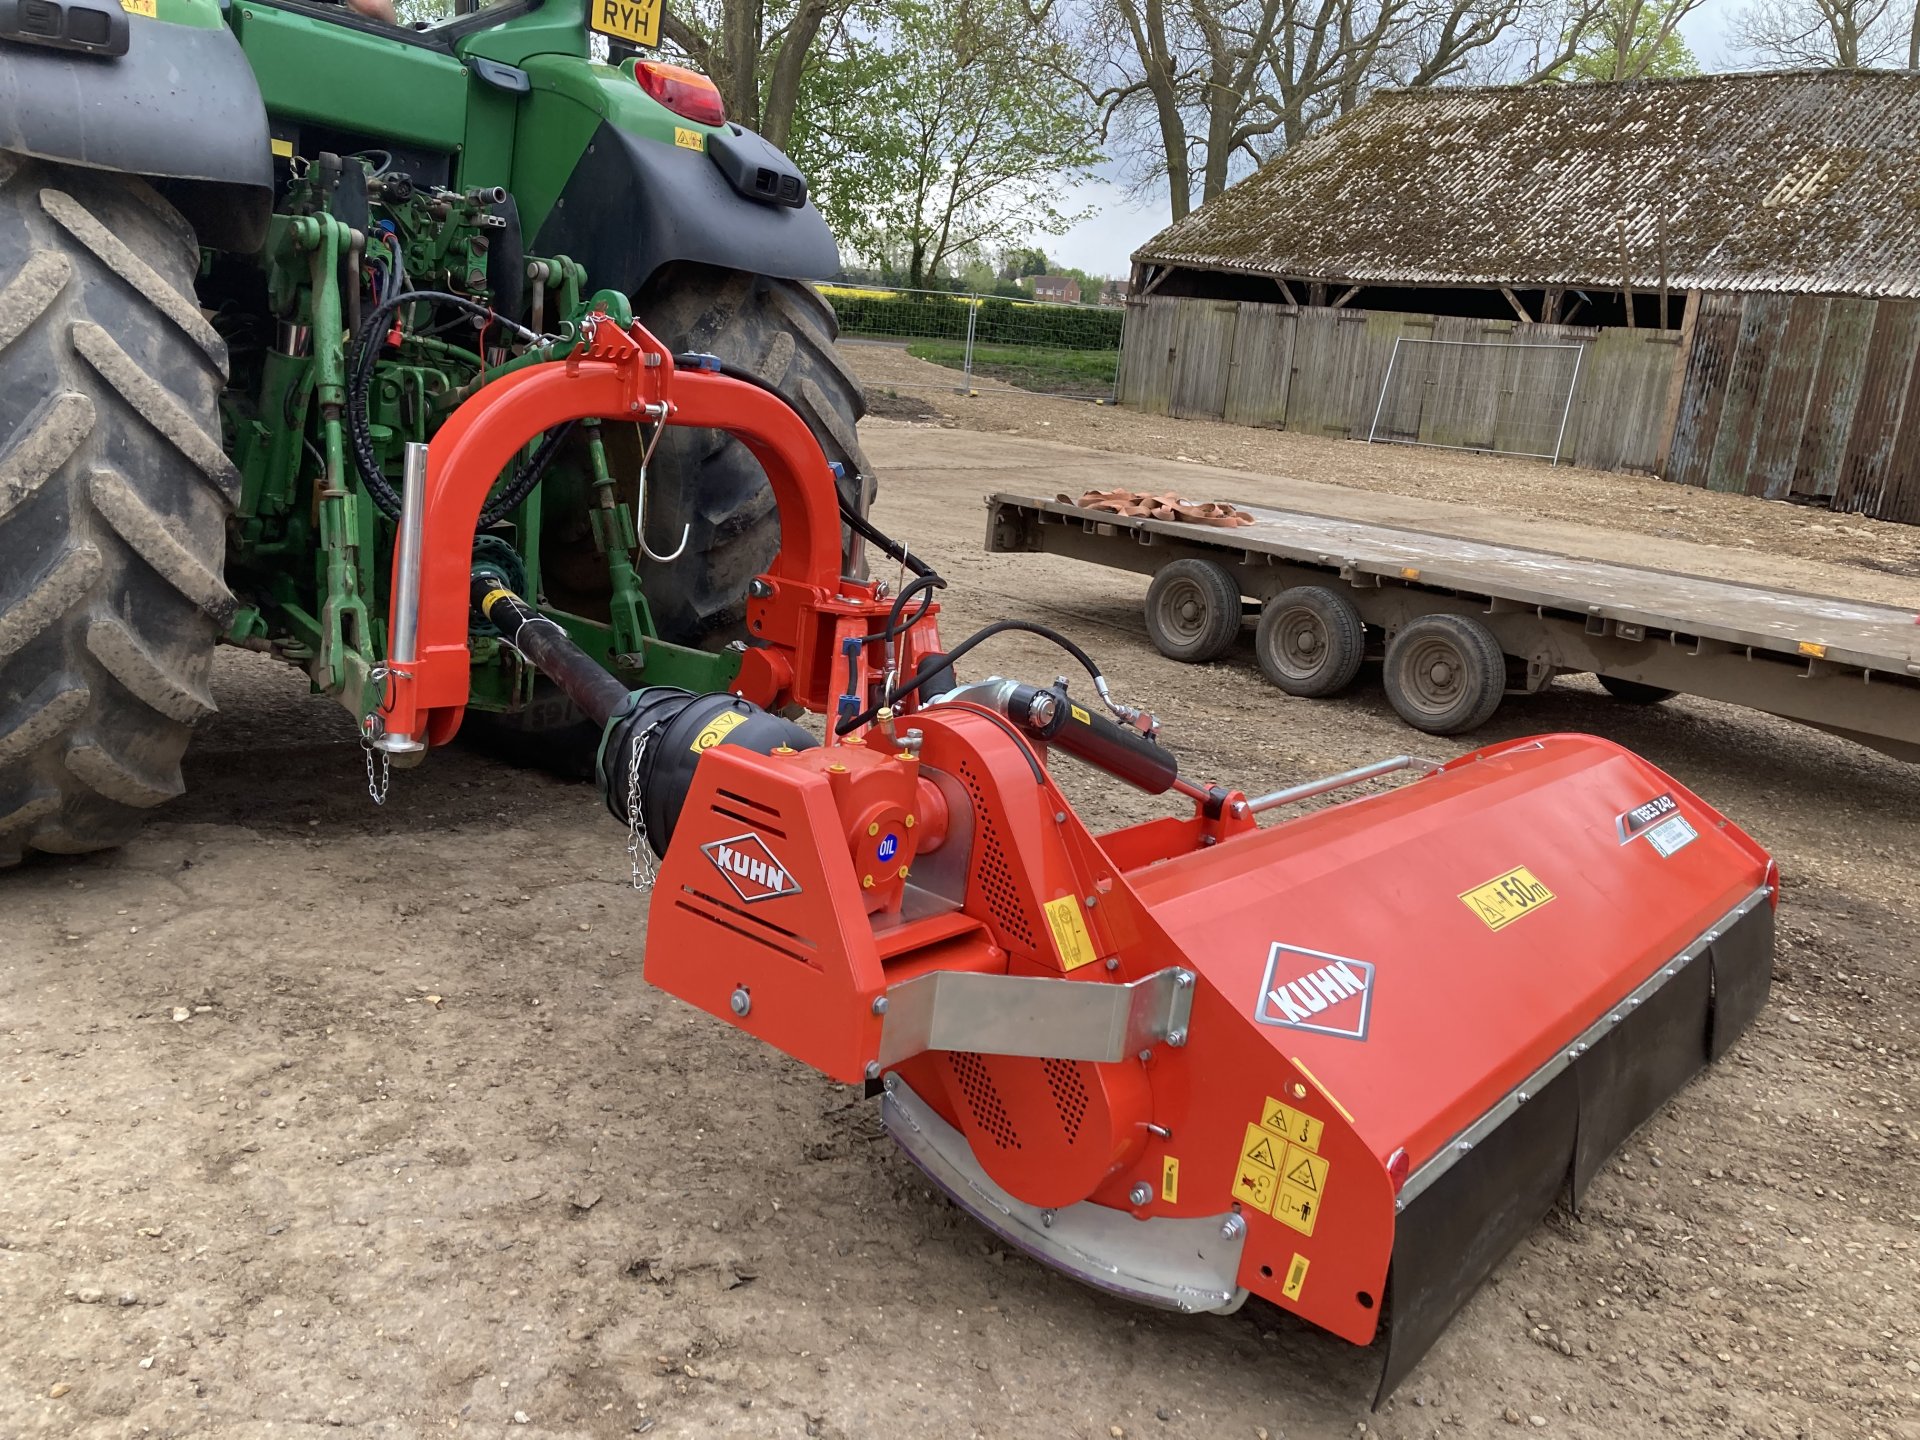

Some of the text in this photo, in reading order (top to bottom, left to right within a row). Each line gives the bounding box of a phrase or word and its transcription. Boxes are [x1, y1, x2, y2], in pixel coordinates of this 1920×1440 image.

[603, 0, 649, 36] RYH
[1631, 795, 1677, 823] TBES 242
[879, 839, 895, 856] OIL
[717, 844, 784, 892] KUHN
[1266, 960, 1367, 1024] KUHN
